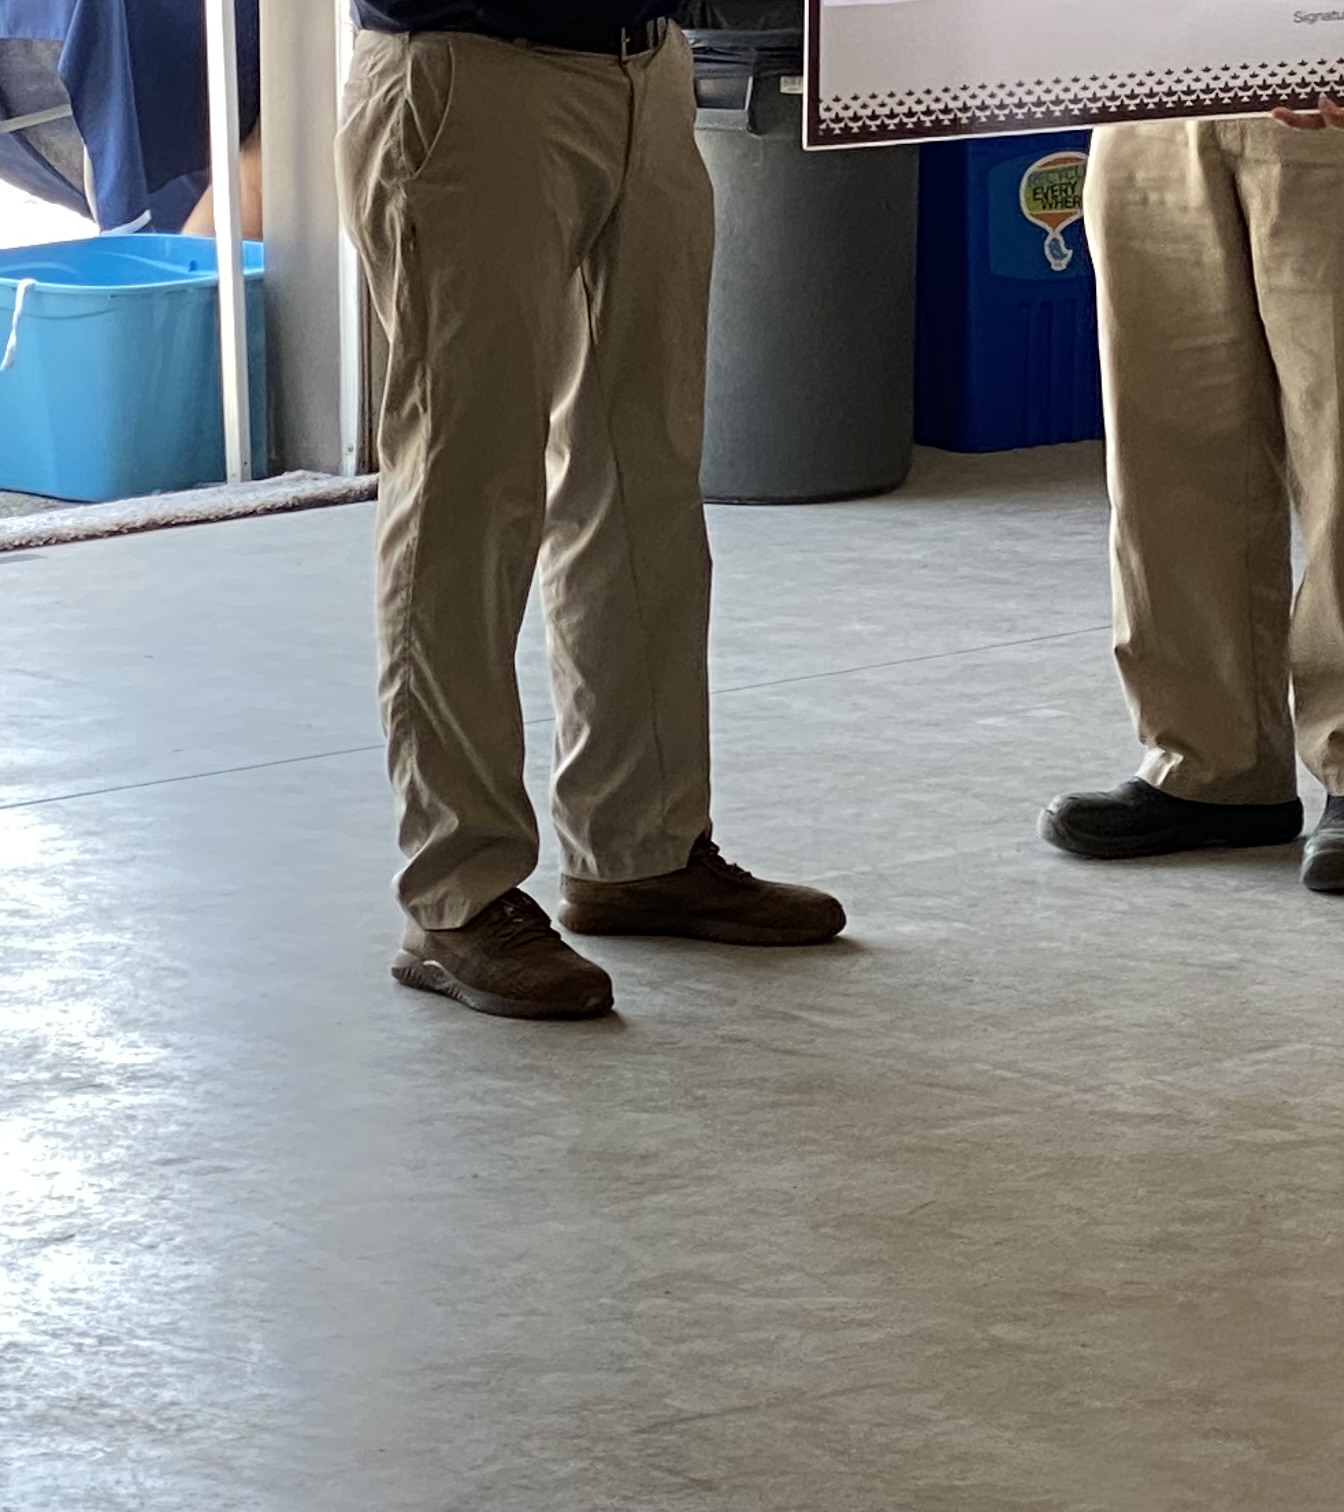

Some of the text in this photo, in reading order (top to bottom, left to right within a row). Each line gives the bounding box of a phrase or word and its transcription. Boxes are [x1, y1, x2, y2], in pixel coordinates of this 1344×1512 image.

[1027, 165, 1086, 186] RECYCL
[1033, 181, 1077, 201] EVERY
[1041, 195, 1083, 210] WHER
